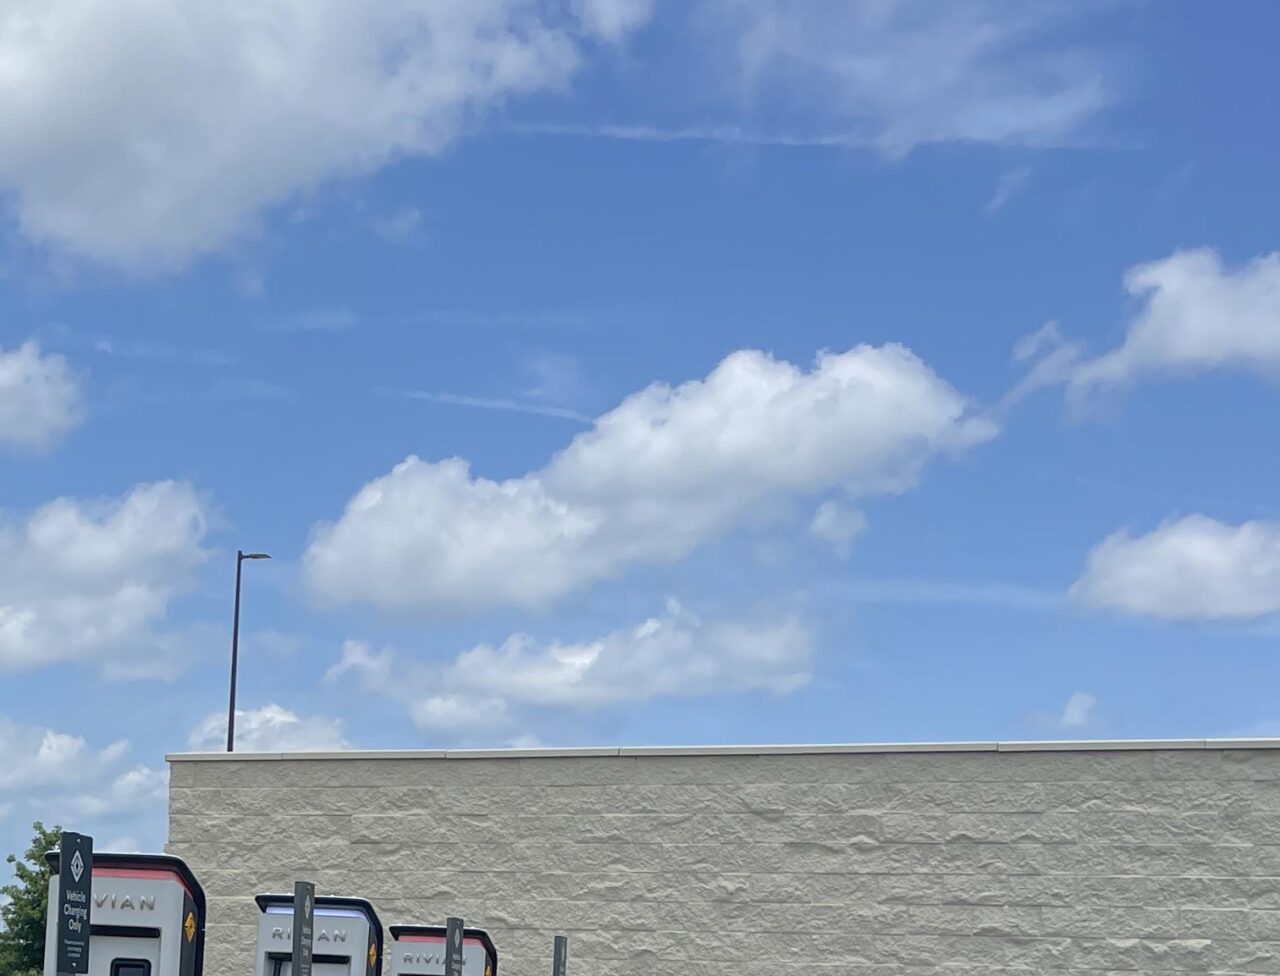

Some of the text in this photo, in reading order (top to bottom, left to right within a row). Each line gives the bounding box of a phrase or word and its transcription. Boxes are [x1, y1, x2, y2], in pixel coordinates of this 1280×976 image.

[93, 893, 155, 911] VIAN
[272, 927, 346, 942] RIAN
[403, 952, 466, 966] RIVI
